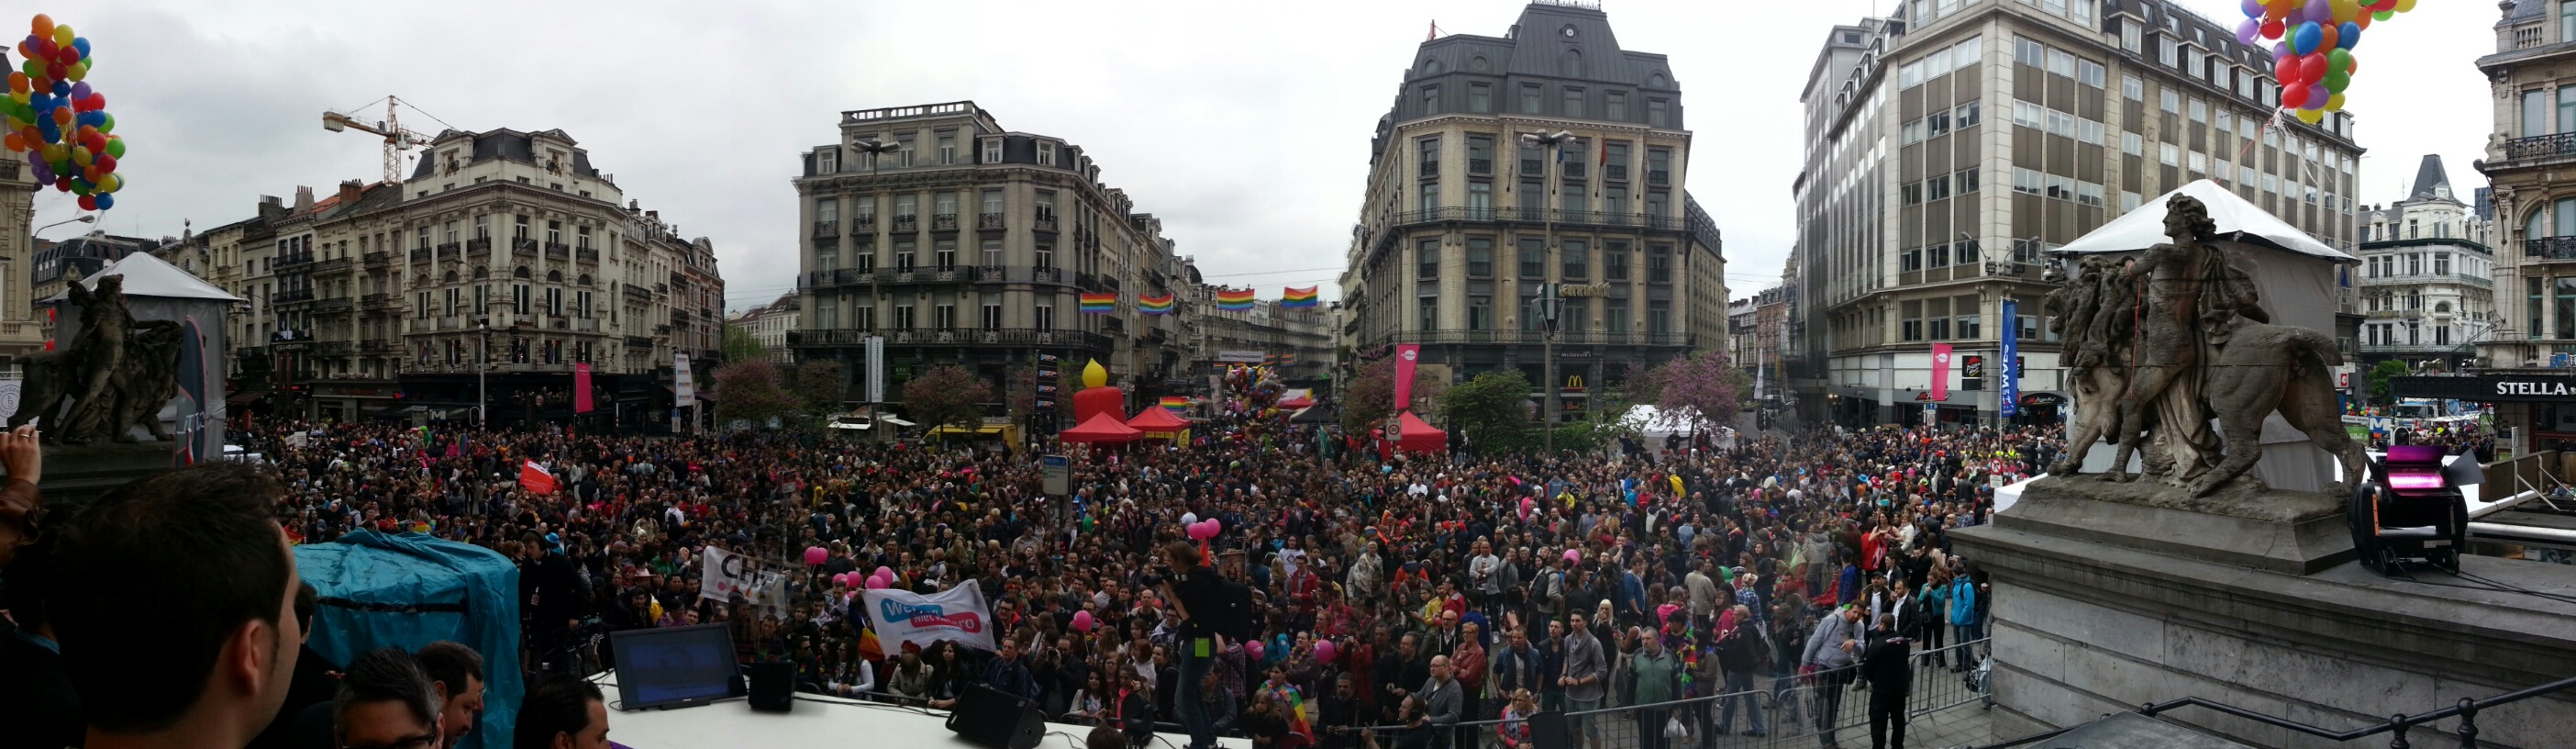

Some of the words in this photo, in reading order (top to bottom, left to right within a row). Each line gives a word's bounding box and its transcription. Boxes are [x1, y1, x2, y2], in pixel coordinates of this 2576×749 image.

[1560, 282, 1611, 297] arriott
[2496, 382, 2569, 396] STELLA
[2369, 418, 2393, 431] M
